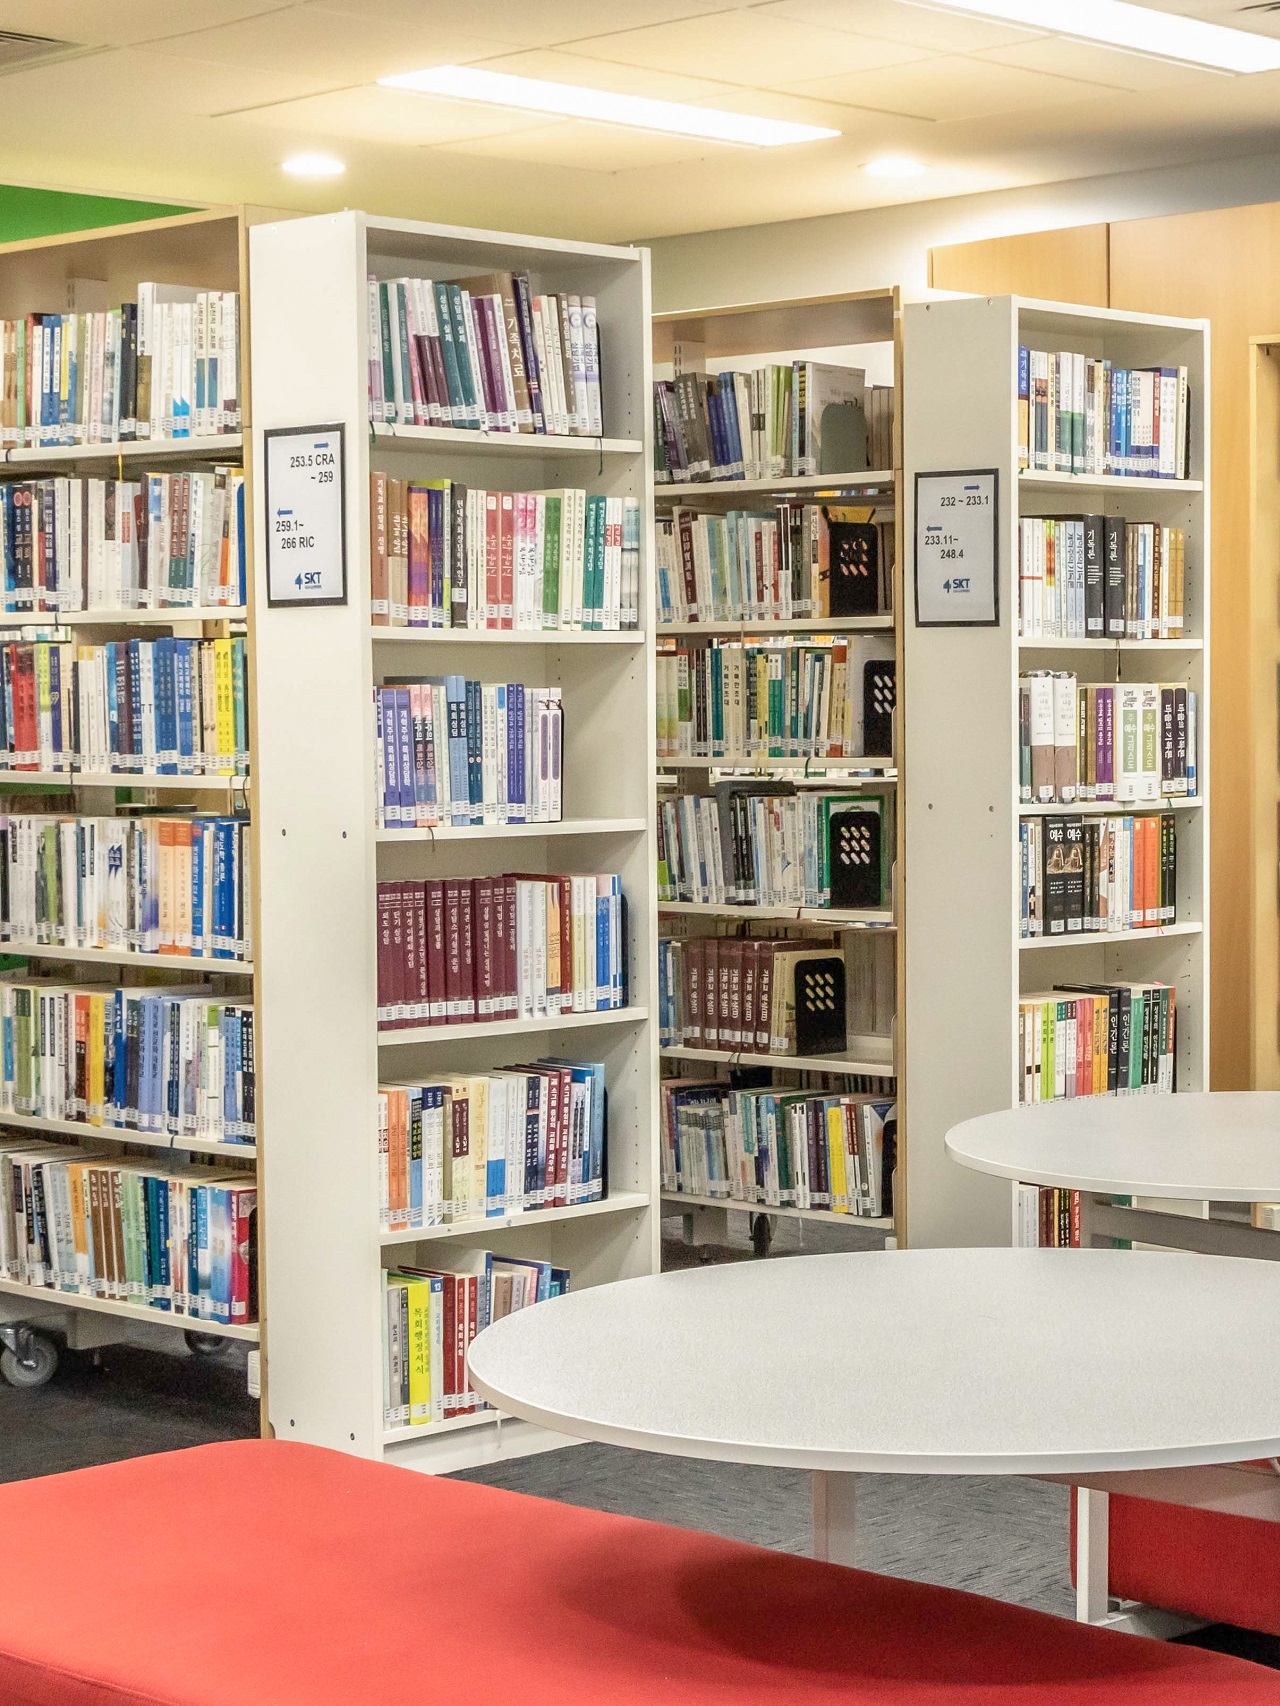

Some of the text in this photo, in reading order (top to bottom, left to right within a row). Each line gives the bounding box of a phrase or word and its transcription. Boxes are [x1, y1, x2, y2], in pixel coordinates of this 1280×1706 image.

[290, 453, 335, 468] 253.5 CRA
[318, 471, 334, 483] 259
[940, 496, 956, 507] 232
[966, 496, 989, 506] 233.1
[281, 536, 315, 550] 266 RIC
[940, 549, 964, 559] 248.4
[304, 572, 322, 584] SKT
[952, 578, 970, 589] SKT
[1050, 829, 1064, 842] 예수
[1067, 828, 1082, 842] 예수
[1110, 1014, 1118, 1054] 인간론
[1122, 1014, 1130, 1052] 인간론
